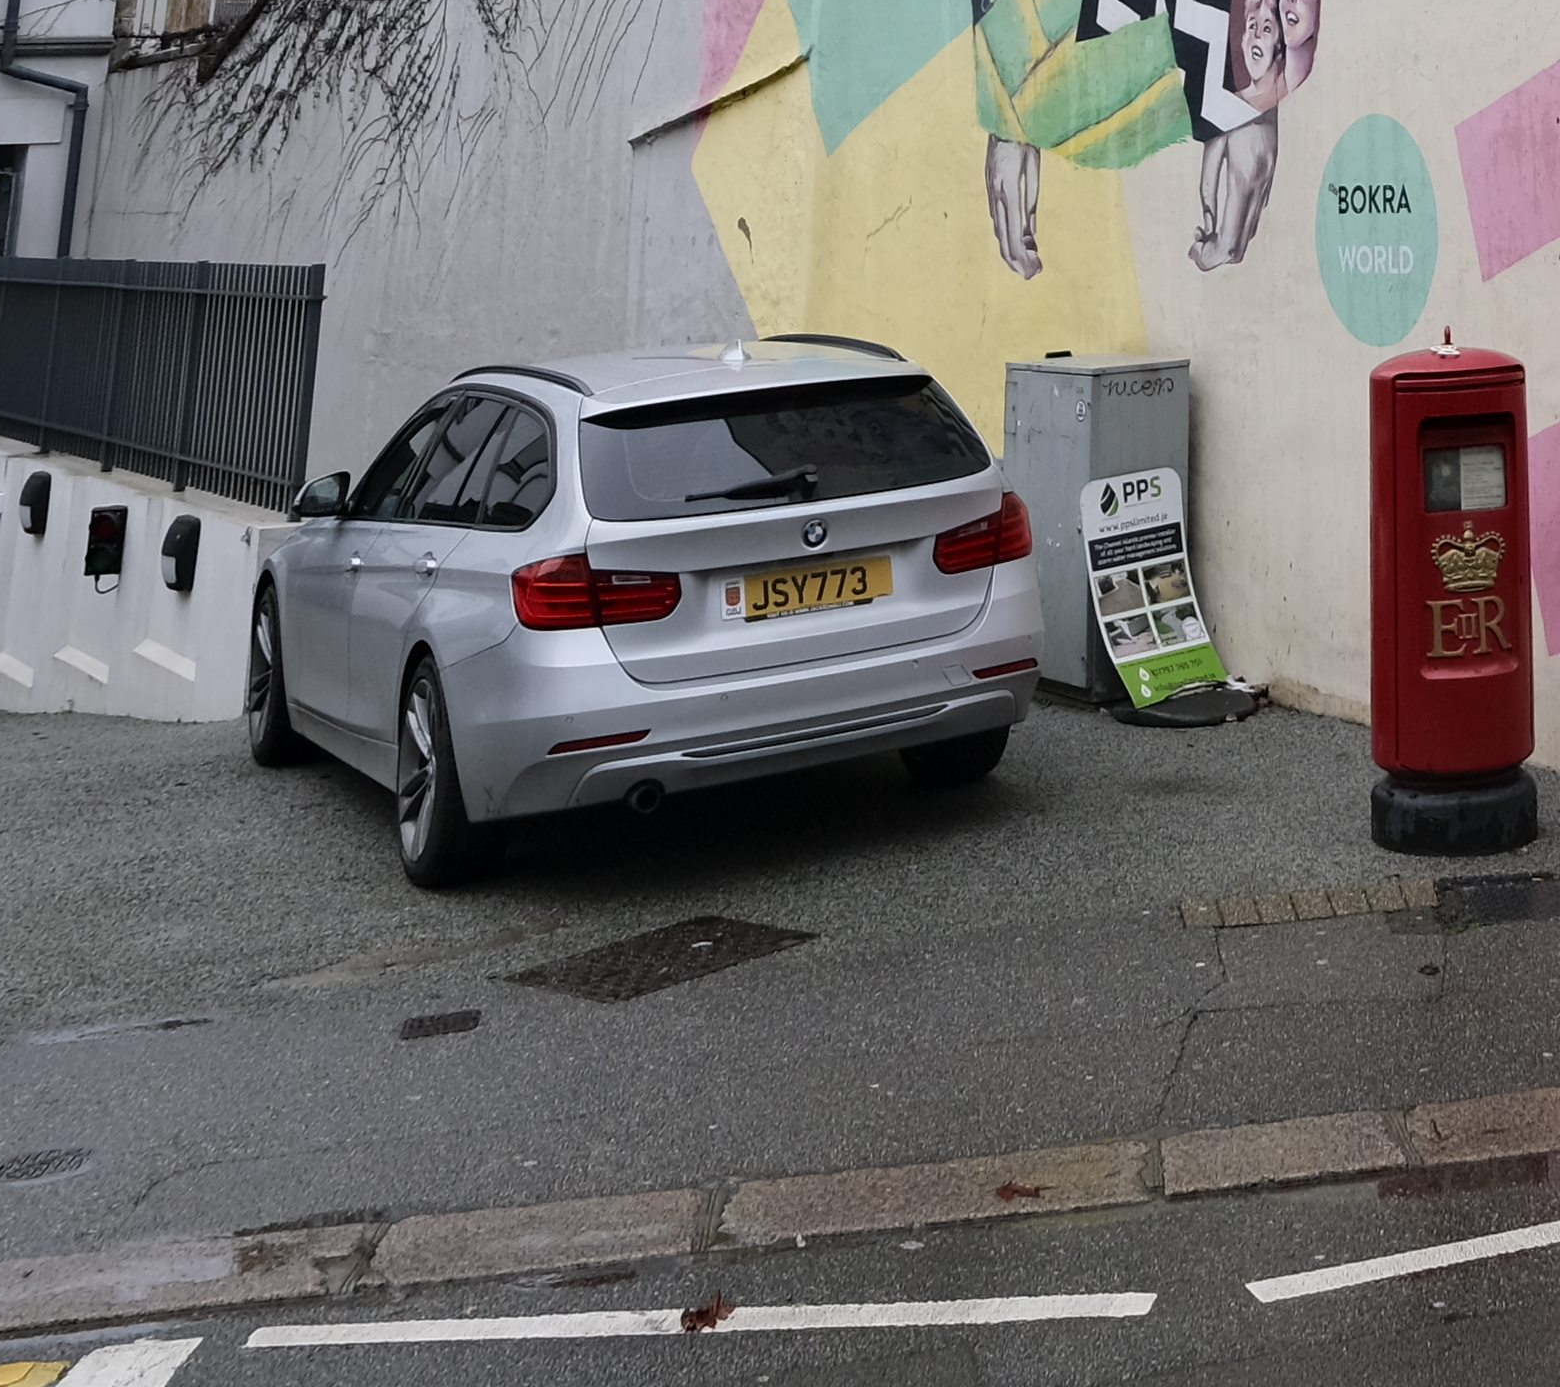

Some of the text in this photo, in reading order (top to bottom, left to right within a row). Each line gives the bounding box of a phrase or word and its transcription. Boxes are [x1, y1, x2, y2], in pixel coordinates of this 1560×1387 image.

[1338, 184, 1412, 214] BOKRA
[1338, 245, 1414, 274] WORLD
[1122, 475, 1162, 504] PPS
[1099, 513, 1168, 533] www.ppslimited.je
[752, 566, 867, 611] JSY773
